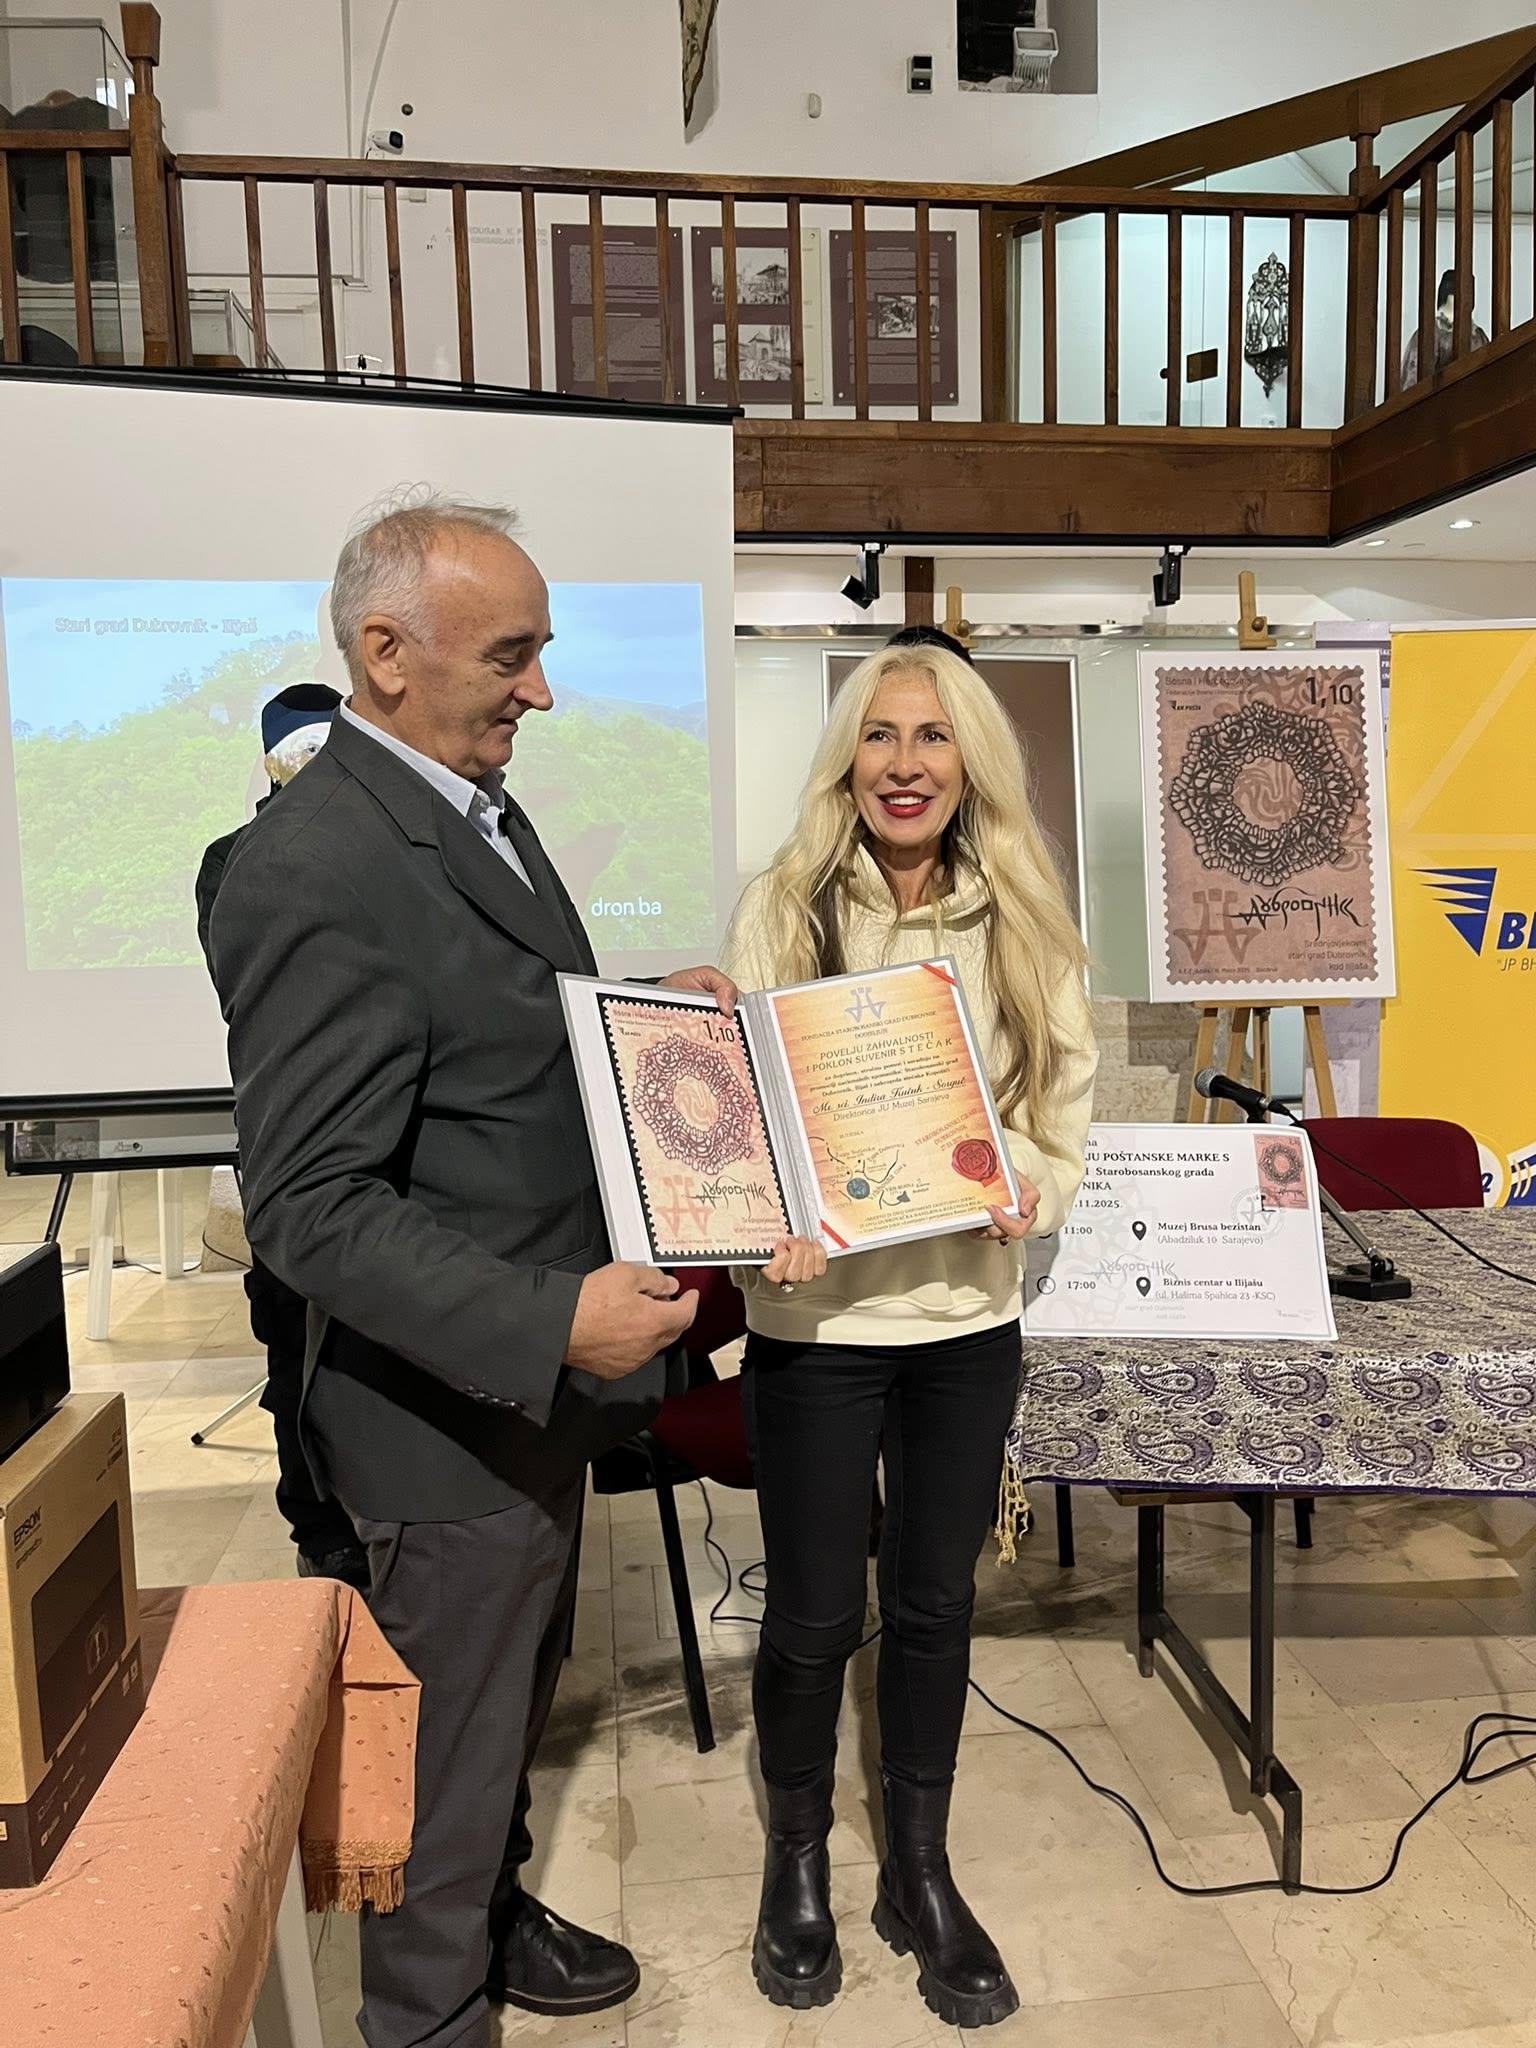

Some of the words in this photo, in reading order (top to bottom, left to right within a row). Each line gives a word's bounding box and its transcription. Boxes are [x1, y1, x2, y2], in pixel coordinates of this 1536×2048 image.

[1305, 676, 1354, 709] 1,10
[703, 1020, 735, 1043] 1,10
[820, 1044, 863, 1060] POVELJU
[867, 1031, 934, 1051] ZAHVALNOSTI
[812, 1057, 853, 1072] POKLON
[855, 1048, 897, 1064] SUVENIR
[833, 1107, 876, 1121] Direktorica
[877, 1103, 890, 1113] JU
[892, 1098, 915, 1110] Muzej
[1103, 1150, 1174, 1162] POŠTANSKE
[1177, 1153, 1221, 1162] MARKE
[1222, 1153, 1230, 1162] S
[1095, 1166, 1182, 1178] Starobosanskog
[1184, 1167, 1215, 1178] grada
[1064, 1226, 1093, 1235] 11:00
[1158, 1222, 1187, 1232] Muzej
[1189, 1222, 1218, 1231] Brusa
[1220, 1221, 1261, 1231] bezistan
[1067, 1281, 1097, 1290] 17:00
[1163, 1278, 1191, 1287] Biznis
[1193, 1279, 1223, 1287] centar
[14, 1504, 41, 1546] EPSON
